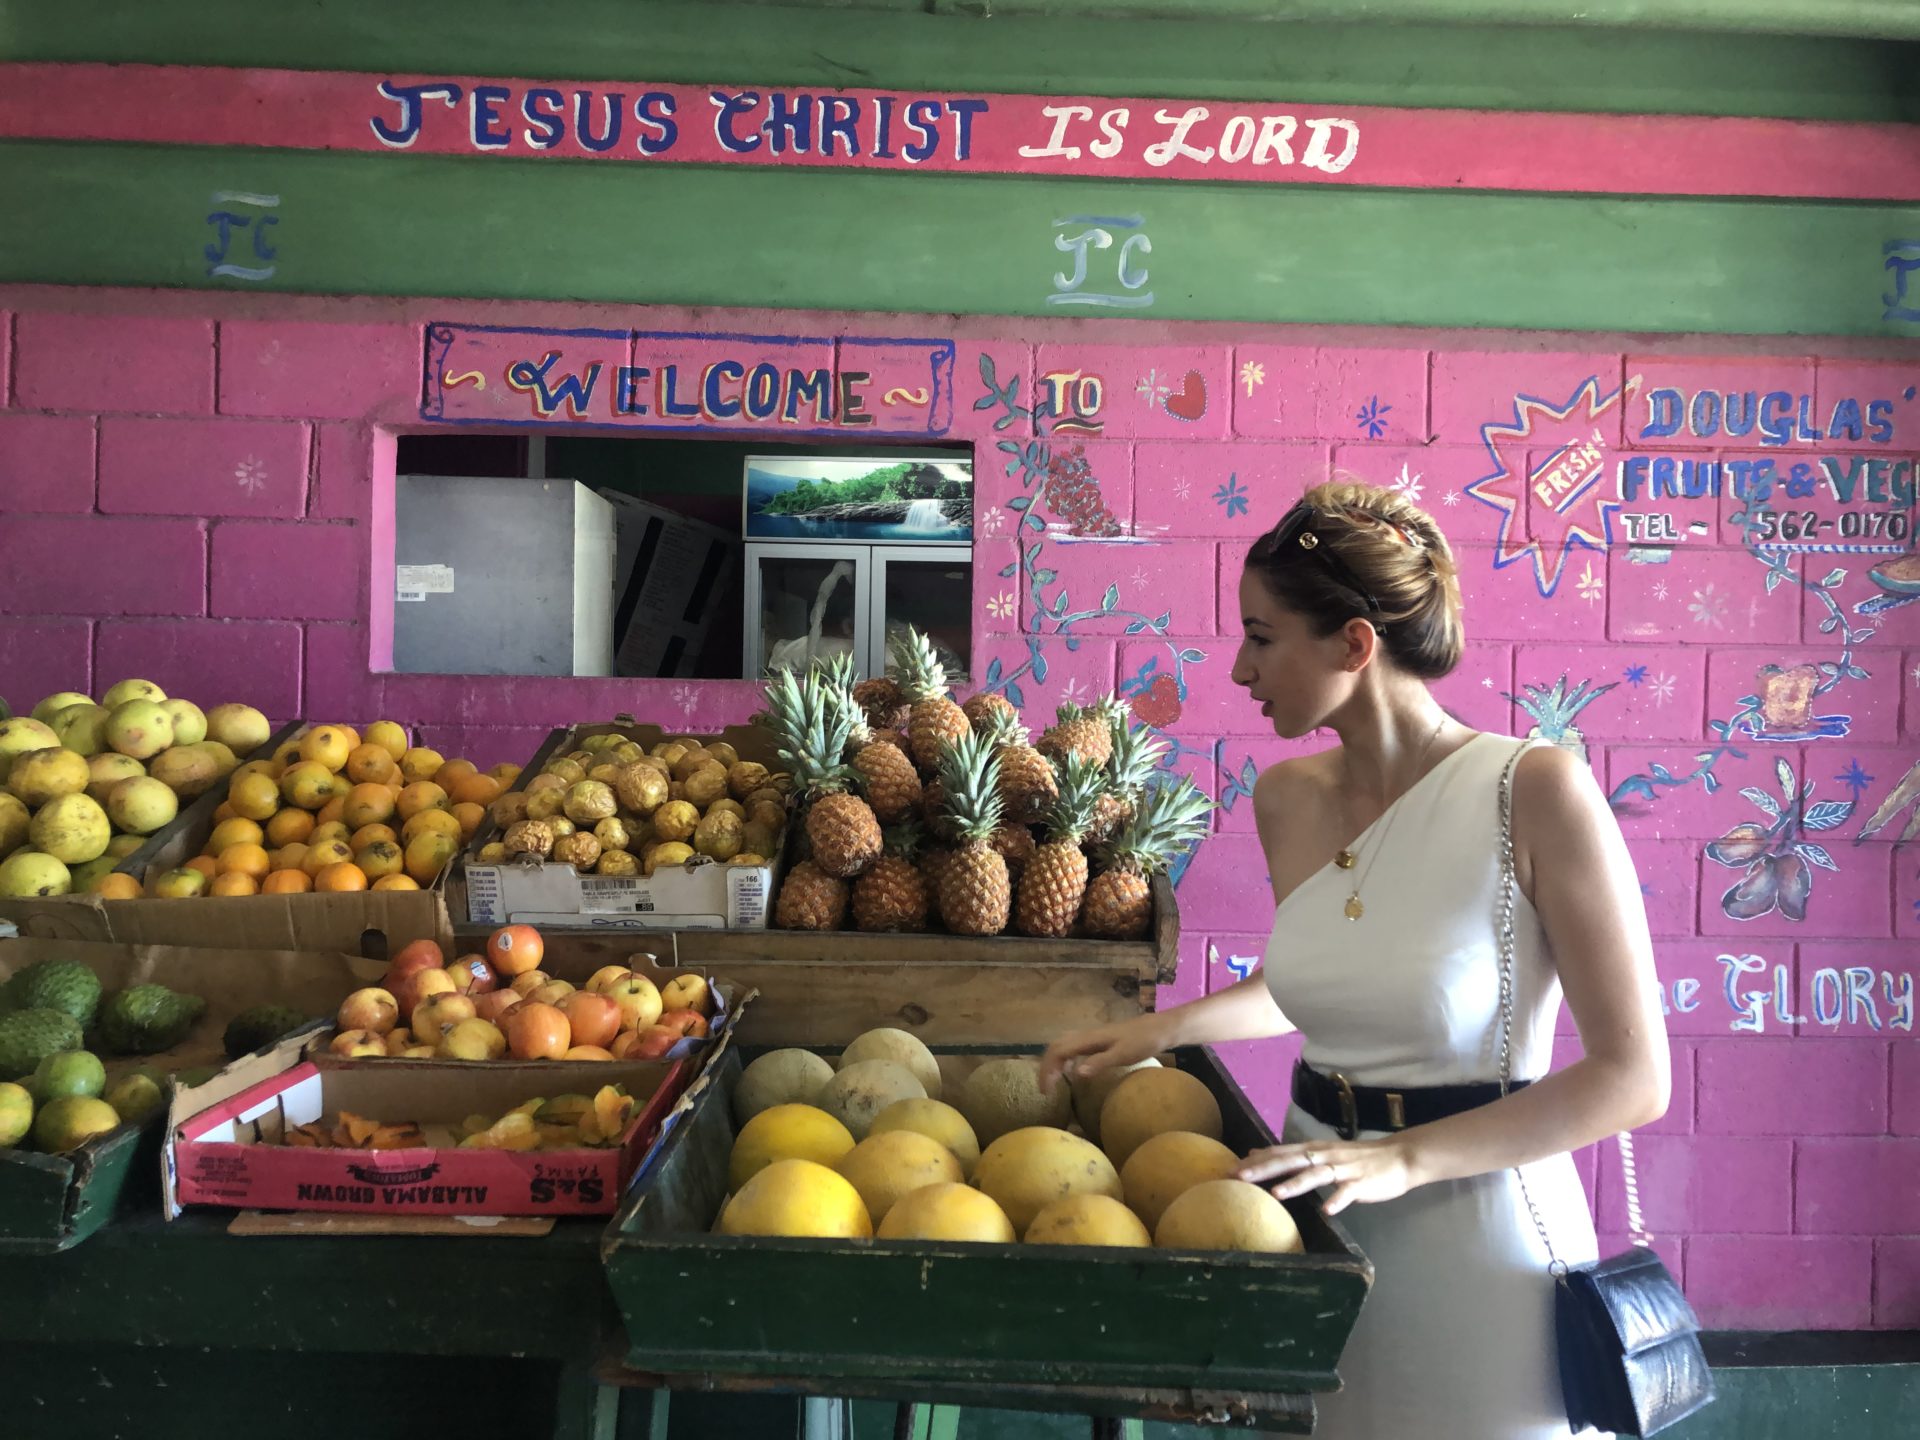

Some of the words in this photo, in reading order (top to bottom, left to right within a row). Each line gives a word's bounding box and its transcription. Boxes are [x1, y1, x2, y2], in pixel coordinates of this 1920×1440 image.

[370, 80, 678, 158] JESUS
[710, 90, 990, 164] CHRIST
[1018, 104, 1130, 161] IS
[1143, 106, 1361, 174] LORD
[1053, 228, 1153, 290] JC
[505, 350, 876, 425] WELCOME
[1043, 371, 1104, 420] TO
[1534, 442, 1602, 507] FRESH
[1757, 510, 1909, 541] 562-0170
[1715, 953, 1914, 1034] GLORY
[297, 1181, 378, 1202] GROWN
[382, 1184, 489, 1205] ALABAMA
[530, 1178, 604, 1204] S&S
